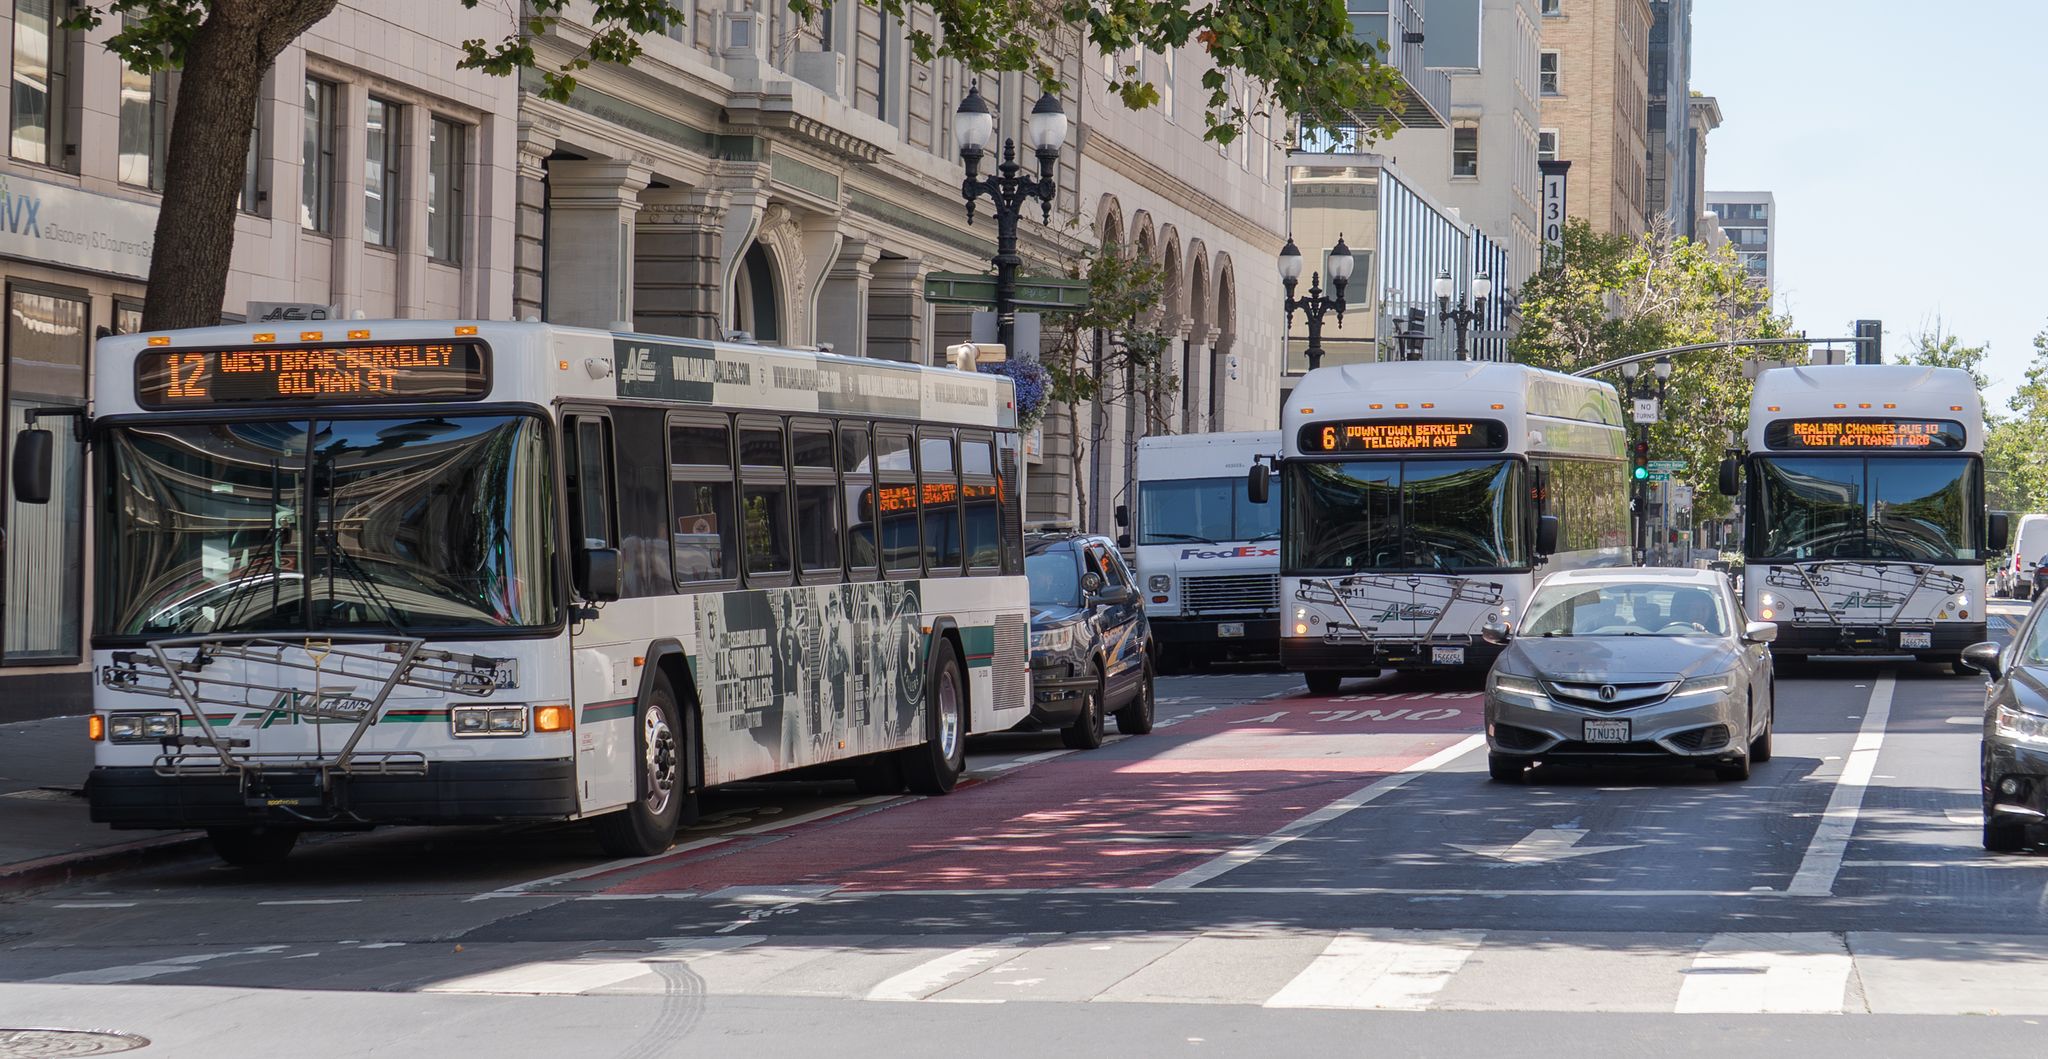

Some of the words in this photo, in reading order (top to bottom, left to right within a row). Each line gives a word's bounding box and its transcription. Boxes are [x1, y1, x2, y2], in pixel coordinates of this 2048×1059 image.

[45, 222, 89, 250] eDiscovery
[92, 231, 99, 248] &
[100, 232, 140, 257] Document
[221, 345, 453, 373] WESTBRAE-BERKELEY
[621, 347, 656, 383] AC
[167, 352, 207, 397] 12
[278, 369, 361, 395] GILMAN
[368, 368, 398, 391] ST
[1323, 427, 1335, 449] 6
[1347, 425, 1412, 437] DOWNTOWN
[1416, 424, 1473, 436] BERKELEY
[1794, 424, 1842, 435] REALIGN
[1845, 424, 1895, 435] CHANGES
[1899, 424, 1922, 434] AUG
[1925, 424, 1938, 434] 10
[1363, 436, 1429, 449] TELEGRAPH
[1433, 435, 1457, 447] AVE
[1803, 435, 1836, 446] VISIT
[1839, 435, 1930, 446] ACTRANSIT.ORG
[1180, 546, 1279, 559] FedEx
[1340, 587, 1364, 598] 11
[715, 650, 728, 681] ALL
[728, 648, 755, 680] SUMMER
[756, 645, 773, 676] LONG
[715, 682, 733, 713] WITH
[733, 680, 746, 711] THE
[746, 677, 773, 709] BALLERS
[1227, 708, 1462, 724] ONLY
[1586, 727, 1627, 740] 7TNU317
